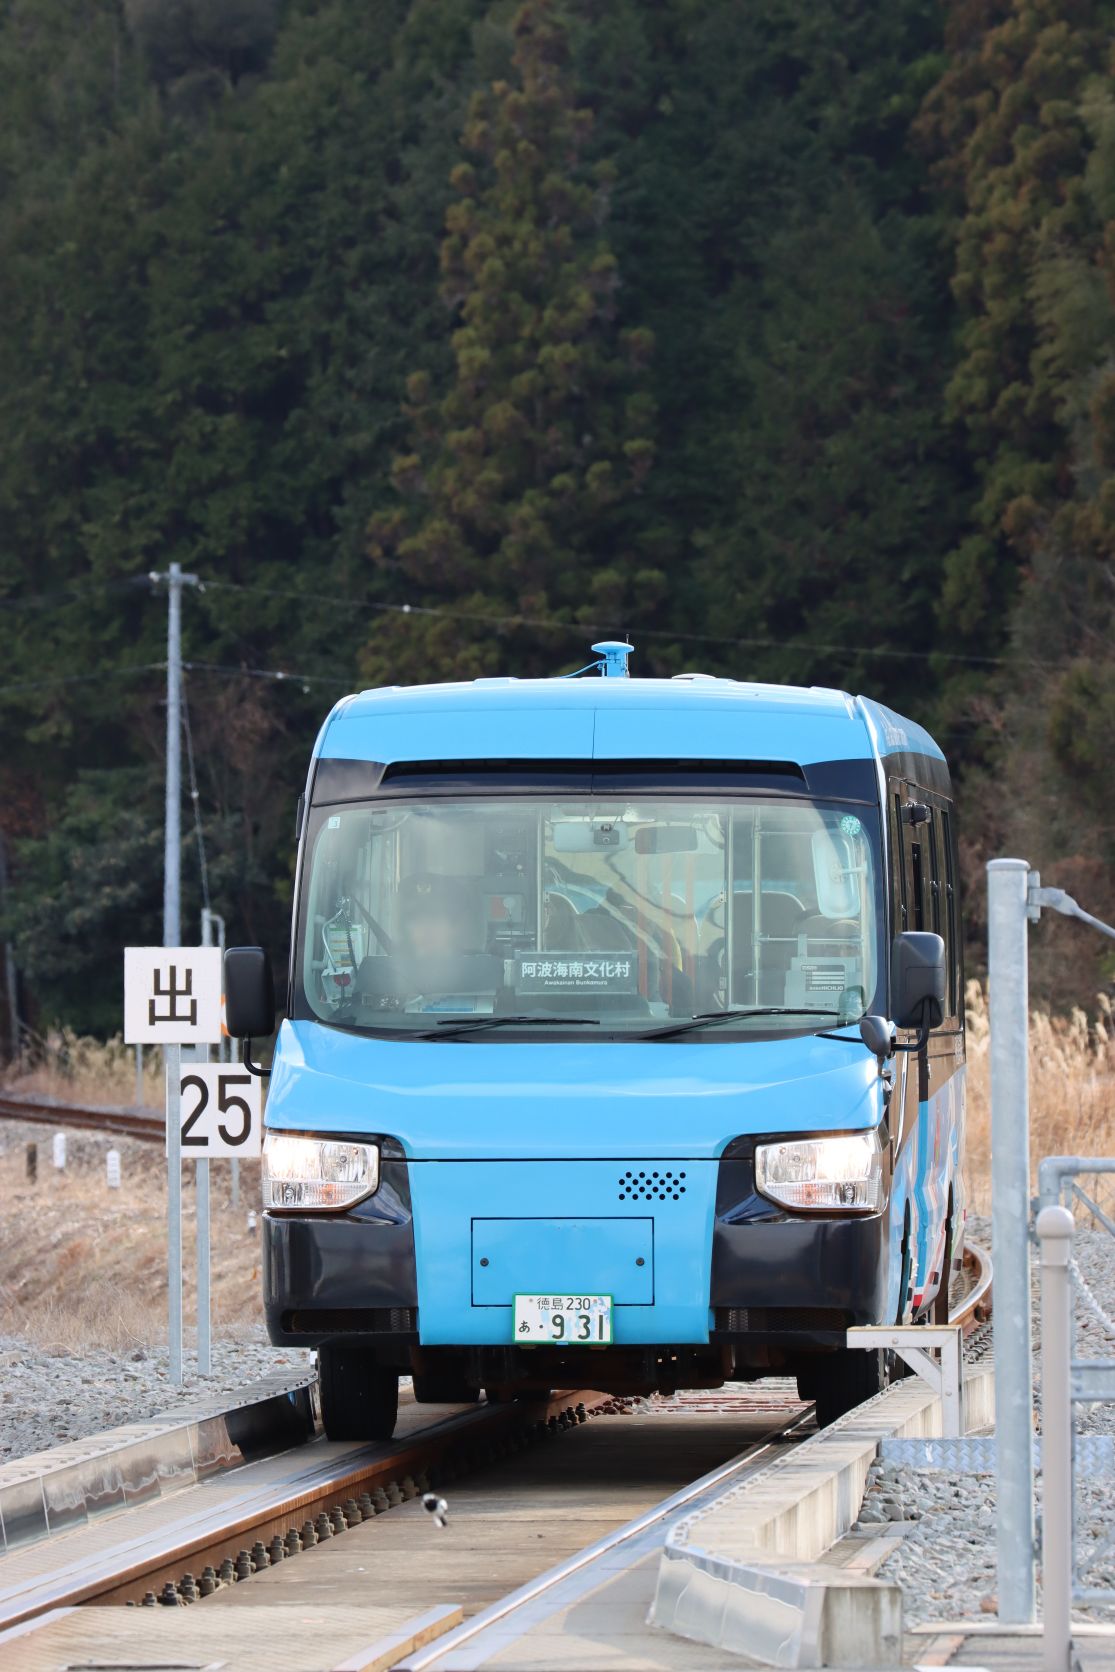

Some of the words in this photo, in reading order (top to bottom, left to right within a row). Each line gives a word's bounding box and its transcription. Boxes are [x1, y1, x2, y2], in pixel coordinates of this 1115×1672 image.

[148, 965, 197, 1026] 出
[521, 961, 631, 978] 阿波海南文化村
[180, 1074, 252, 1146] 25
